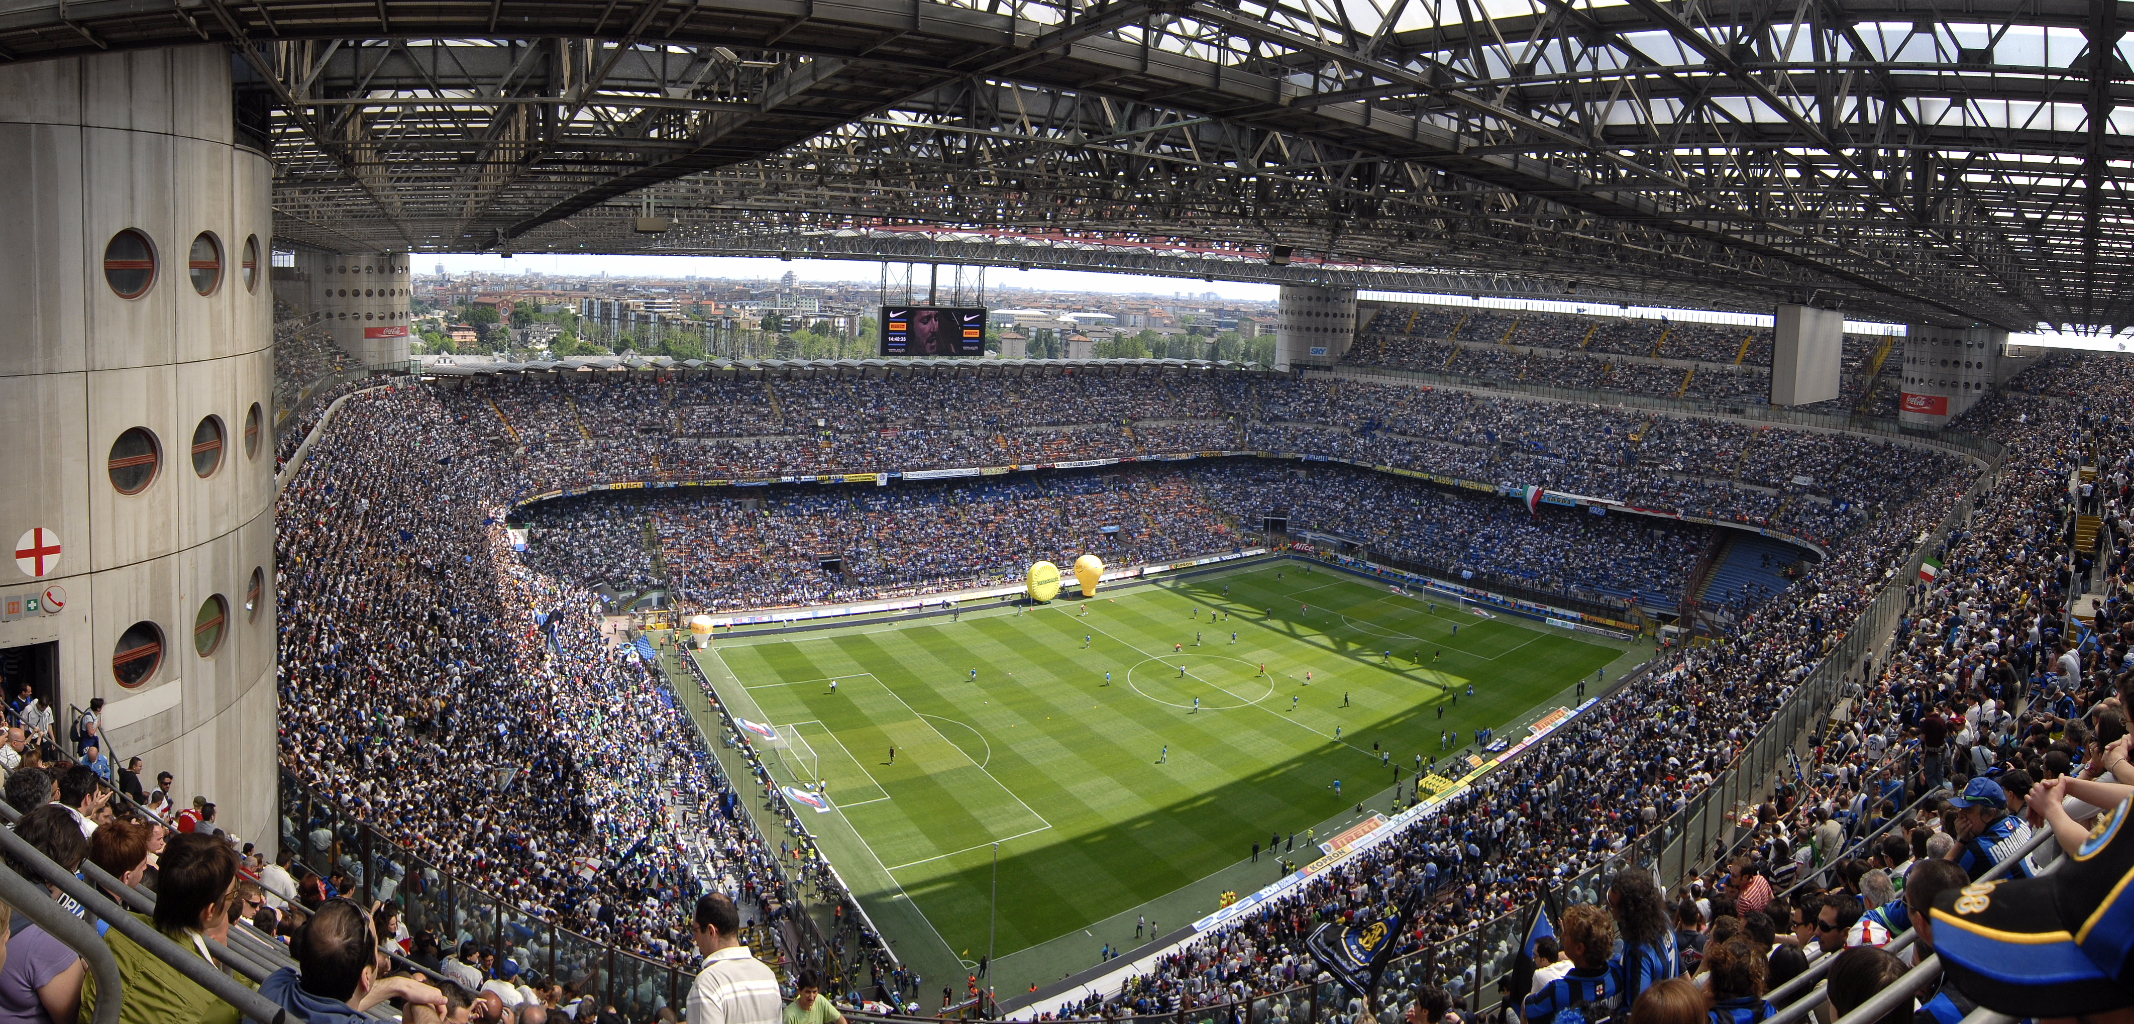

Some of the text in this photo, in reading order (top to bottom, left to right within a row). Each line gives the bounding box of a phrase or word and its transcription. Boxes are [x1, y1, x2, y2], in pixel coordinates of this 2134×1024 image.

[609, 482, 643, 490] ROVIGO
[1328, 818, 1382, 850] PIRELLI
[1309, 849, 1347, 871] KOPRON
[1259, 884, 1281, 898] SDA
